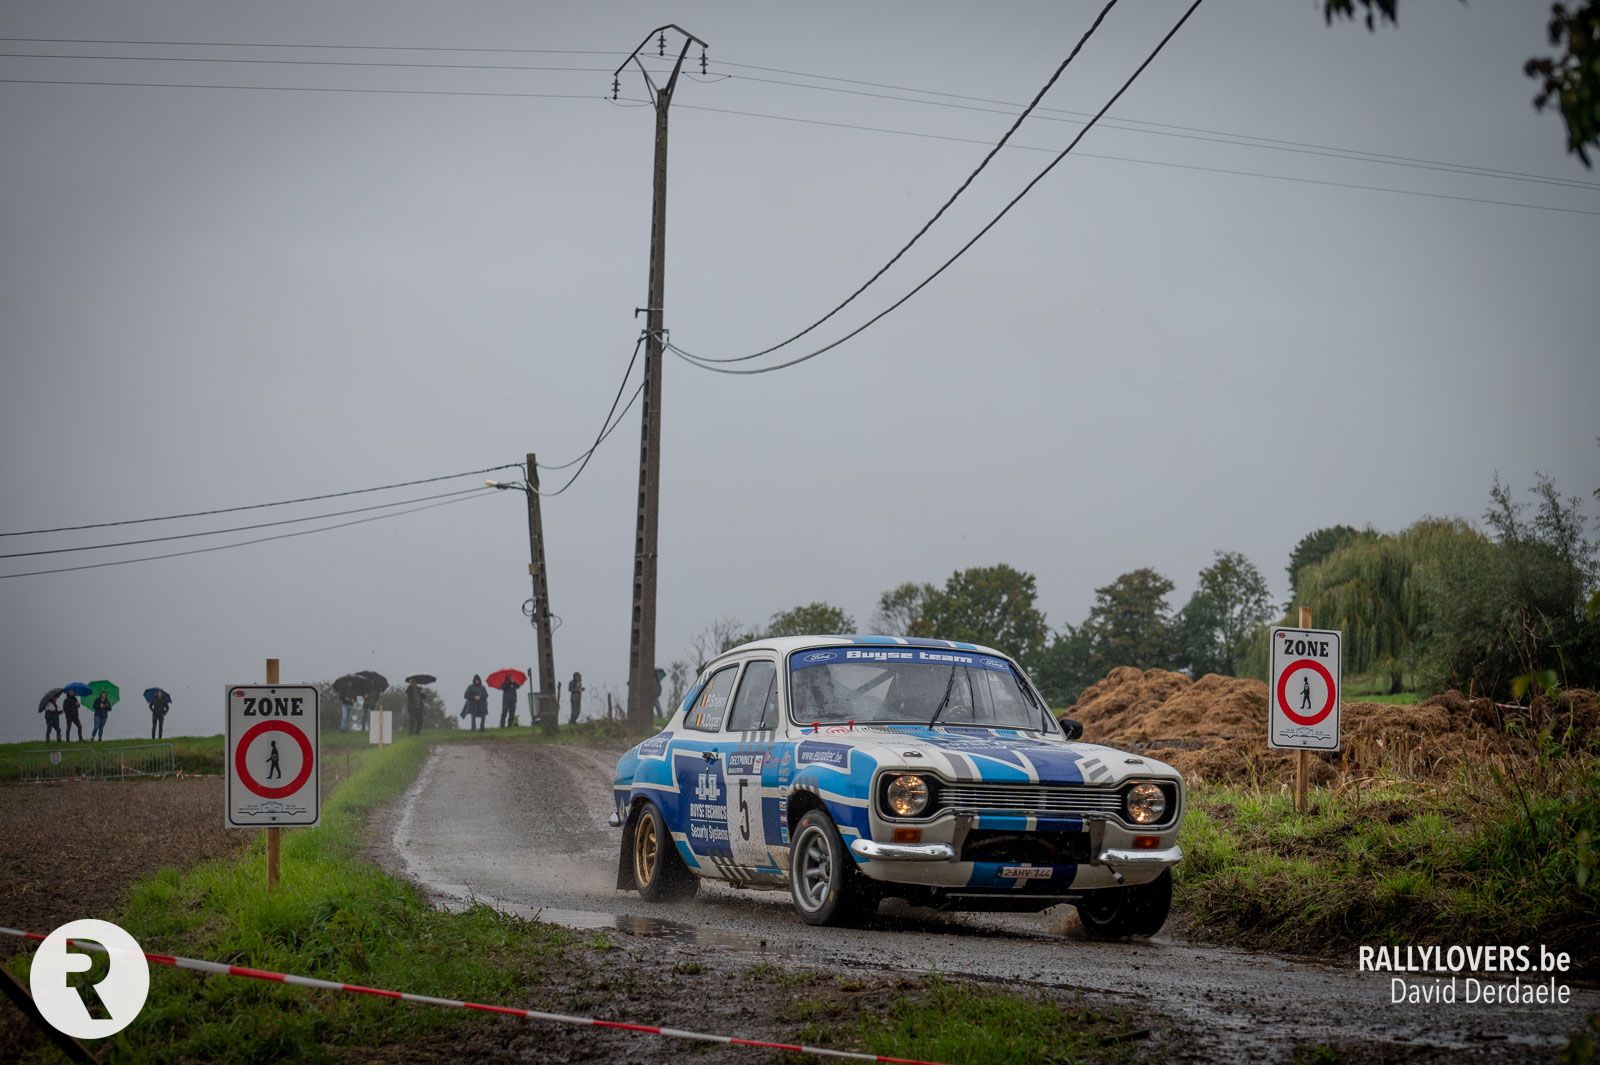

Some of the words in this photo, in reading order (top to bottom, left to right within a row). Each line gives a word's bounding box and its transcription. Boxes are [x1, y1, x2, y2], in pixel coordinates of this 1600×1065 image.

[846, 650, 913, 660] Buyse
[919, 651, 973, 664] team
[1284, 639, 1329, 657] ZONE
[807, 653, 834, 662] Ford
[243, 698, 304, 716] ZONE
[739, 778, 750, 841] 5
[691, 823, 709, 842] Security
[708, 825, 729, 842] Systems
[1003, 868, 1051, 878] 2-AHV-744
